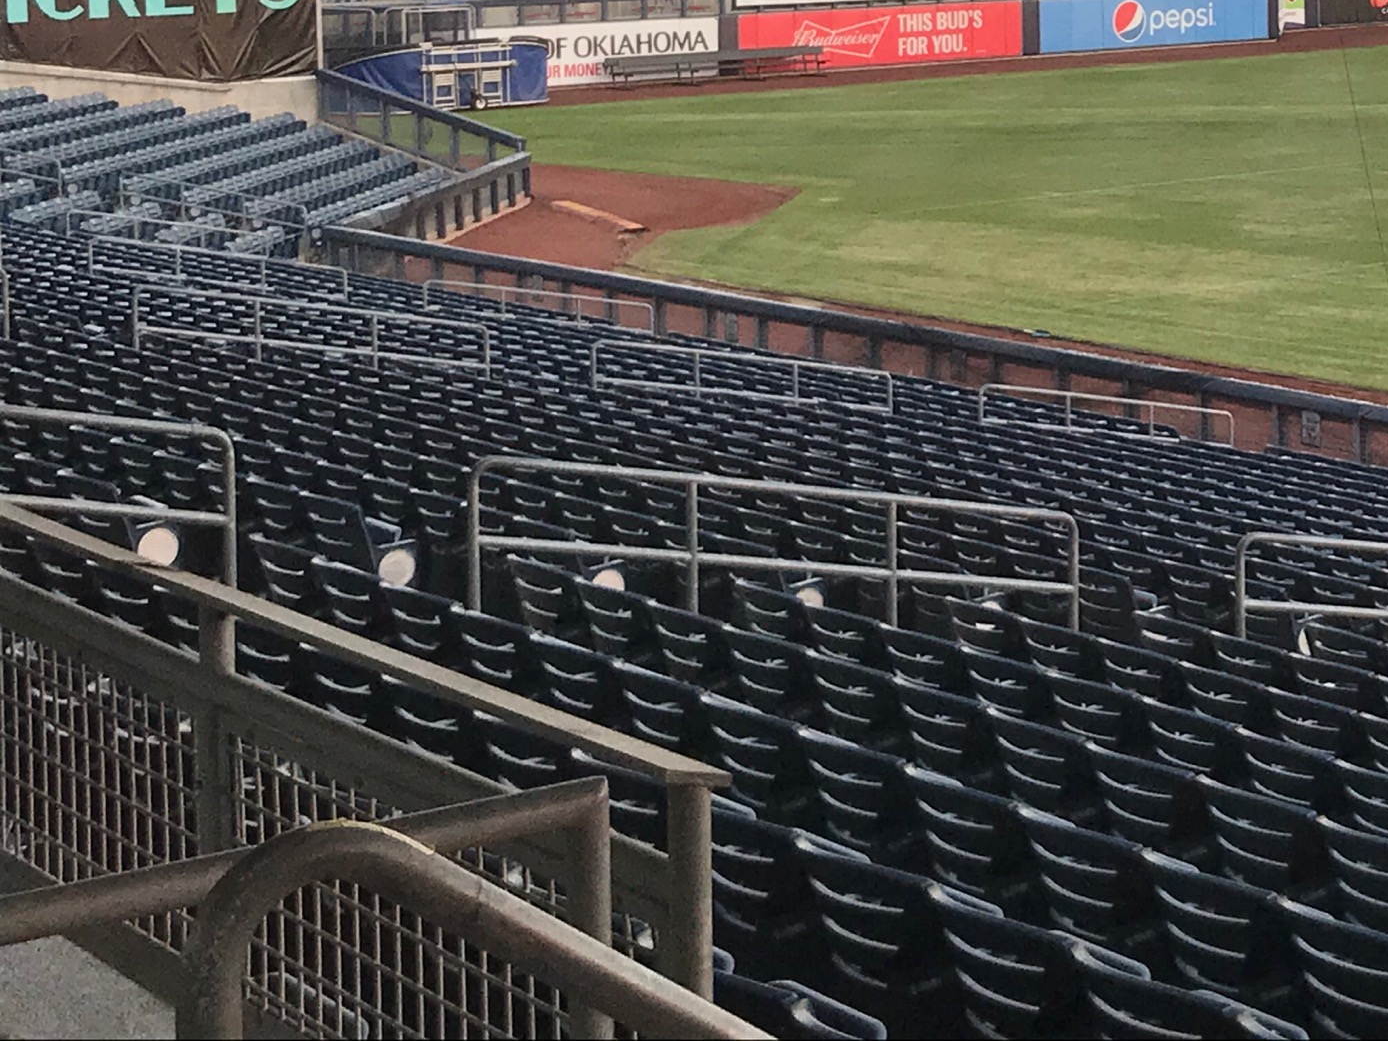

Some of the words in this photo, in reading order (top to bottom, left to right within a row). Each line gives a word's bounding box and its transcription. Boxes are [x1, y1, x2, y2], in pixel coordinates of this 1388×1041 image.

[897, 12, 933, 33] THIS
[937, 10, 983, 31] BUD'S
[1150, 2, 1214, 35] pepsi
[573, 30, 709, 59] OKLAHOMA
[791, 30, 881, 47] Budweiser
[897, 37, 928, 57] FOR
[933, 34, 968, 55] YOU.
